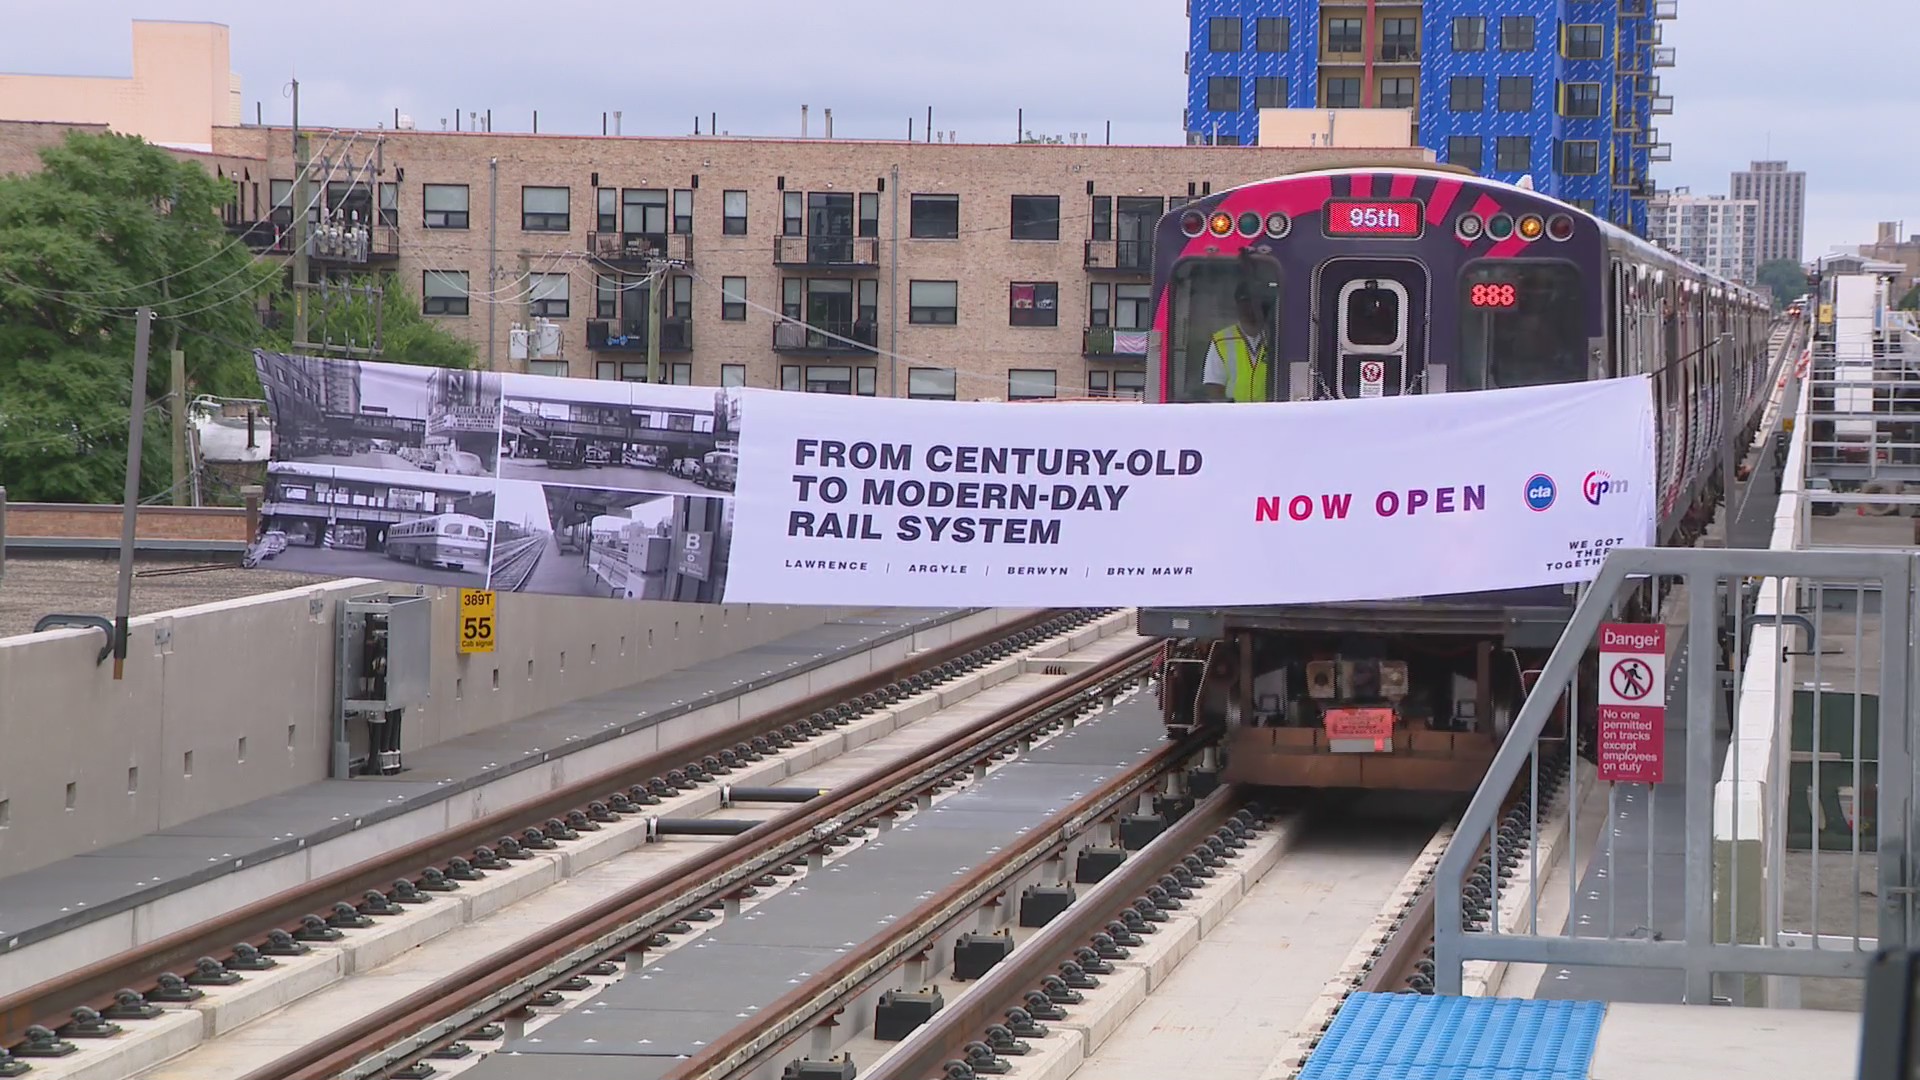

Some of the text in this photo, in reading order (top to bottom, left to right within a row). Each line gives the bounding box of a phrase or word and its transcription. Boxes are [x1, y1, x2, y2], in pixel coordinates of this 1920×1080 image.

[1349, 207, 1401, 229] 95th
[1471, 283, 1516, 307] 888
[795, 438, 1203, 477] FROM CENTURY-OLD
[792, 475, 1129, 512] TO MODERN-DAY
[1529, 486, 1552, 499] cta
[1587, 477, 1629, 506] rpm
[1255, 484, 1486, 522] NOW OPEN
[787, 510, 1062, 545] RAIL SYSTEM
[685, 533, 701, 550] B
[1569, 537, 1624, 550] WE GOT
[785, 559, 869, 571] LAWRENCE
[908, 564, 968, 575] ARGYLE
[1546, 557, 1606, 571] TOGETH
[1007, 566, 1069, 576] BERWYN
[1106, 566, 1195, 577] BRYN MAWR
[464, 593, 493, 606] 389T
[463, 616, 492, 639] 55
[461, 640, 494, 648] Cab signal
[1604, 630, 1660, 649] Danger
[1603, 709, 1640, 720] No one
[1603, 720, 1652, 732] permitted
[1603, 730, 1651, 741] on tracks
[1602, 742, 1637, 753] except
[1602, 751, 1658, 763] employees
[1602, 761, 1642, 774] on duty
